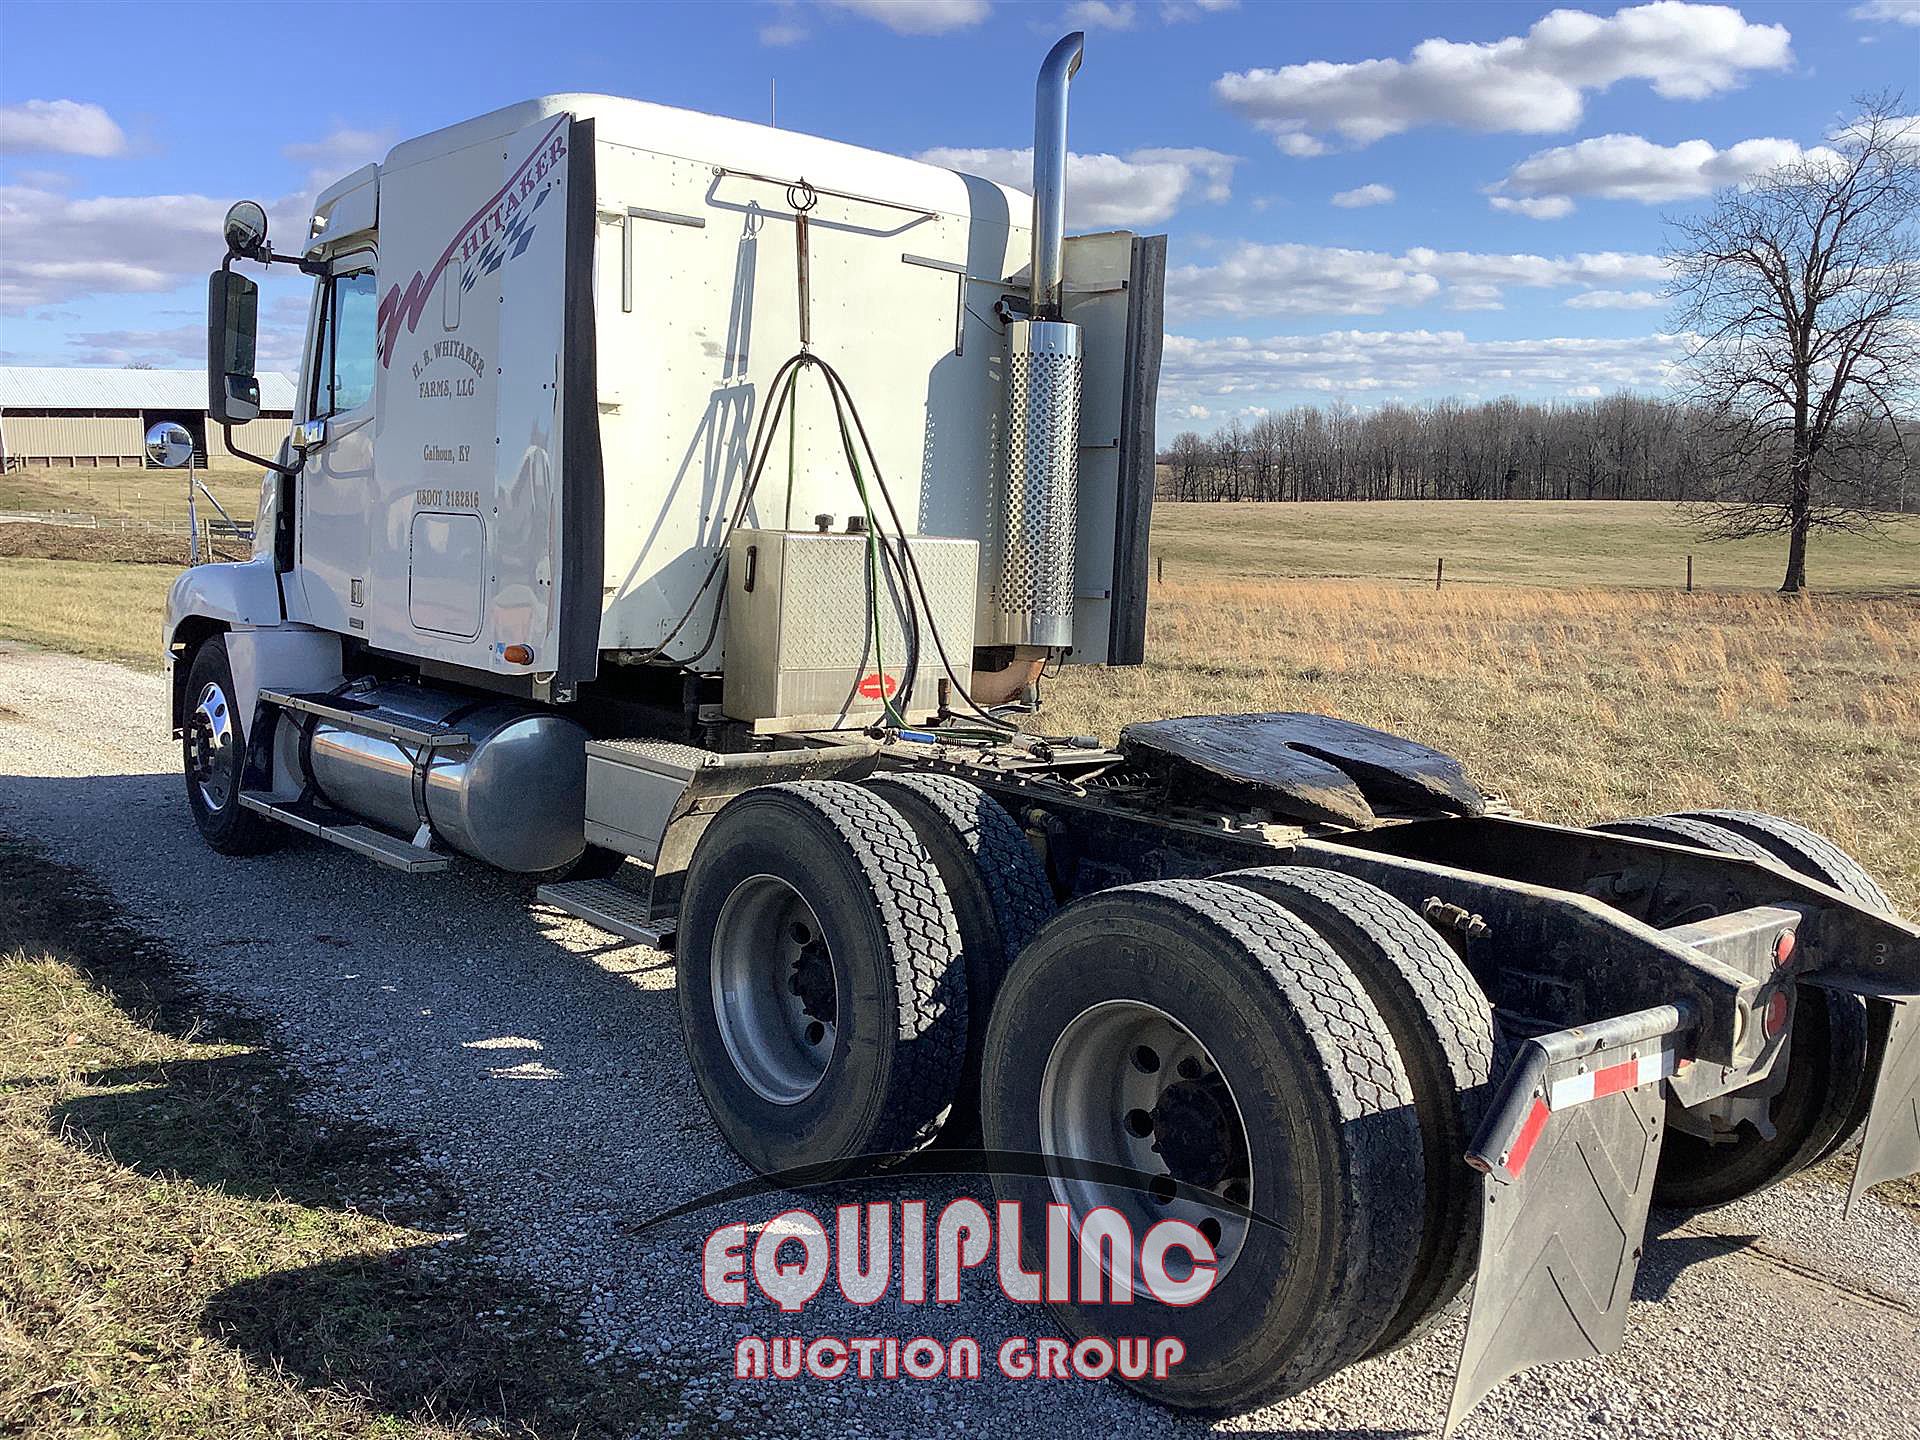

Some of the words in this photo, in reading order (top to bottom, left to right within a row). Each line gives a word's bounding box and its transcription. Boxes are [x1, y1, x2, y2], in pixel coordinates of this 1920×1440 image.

[377, 135, 568, 369] WHITAKER
[412, 361, 424, 380] H.
[433, 340, 485, 378] WHITAKER
[419, 380, 452, 400] FARMS,
[458, 445, 471, 462] KY
[416, 489, 443, 506] USDOT
